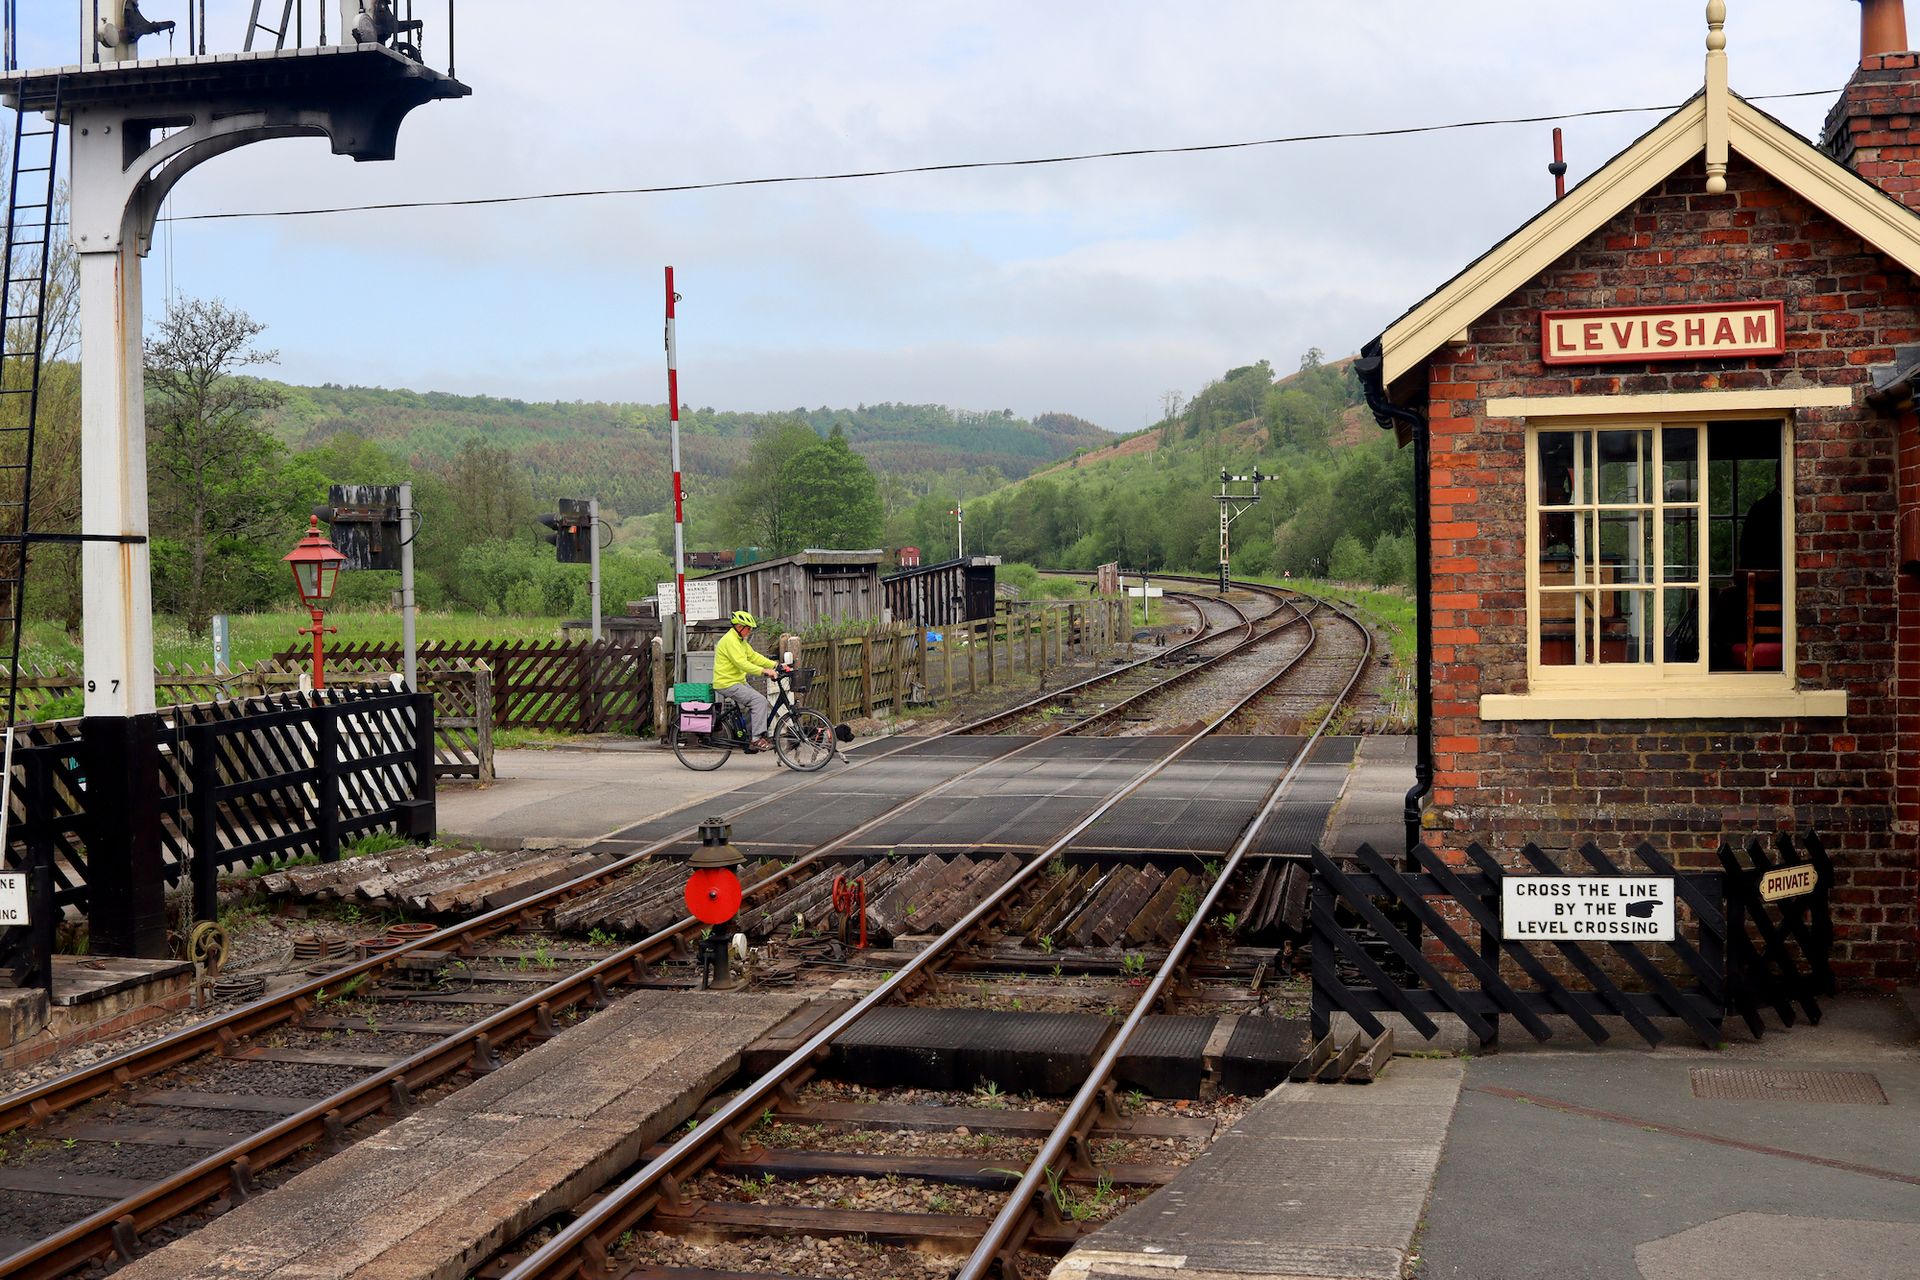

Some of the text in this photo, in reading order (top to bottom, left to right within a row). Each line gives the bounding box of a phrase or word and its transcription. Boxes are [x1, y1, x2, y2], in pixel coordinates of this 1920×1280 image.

[1556, 315, 1767, 351] LEVISHAM
[1767, 872, 1810, 893] PRIVATE
[1516, 883, 1658, 897] CROSS THE LINE
[1555, 903, 1616, 915] BY THE
[1518, 921, 1658, 934] LEVEL CROSSING
